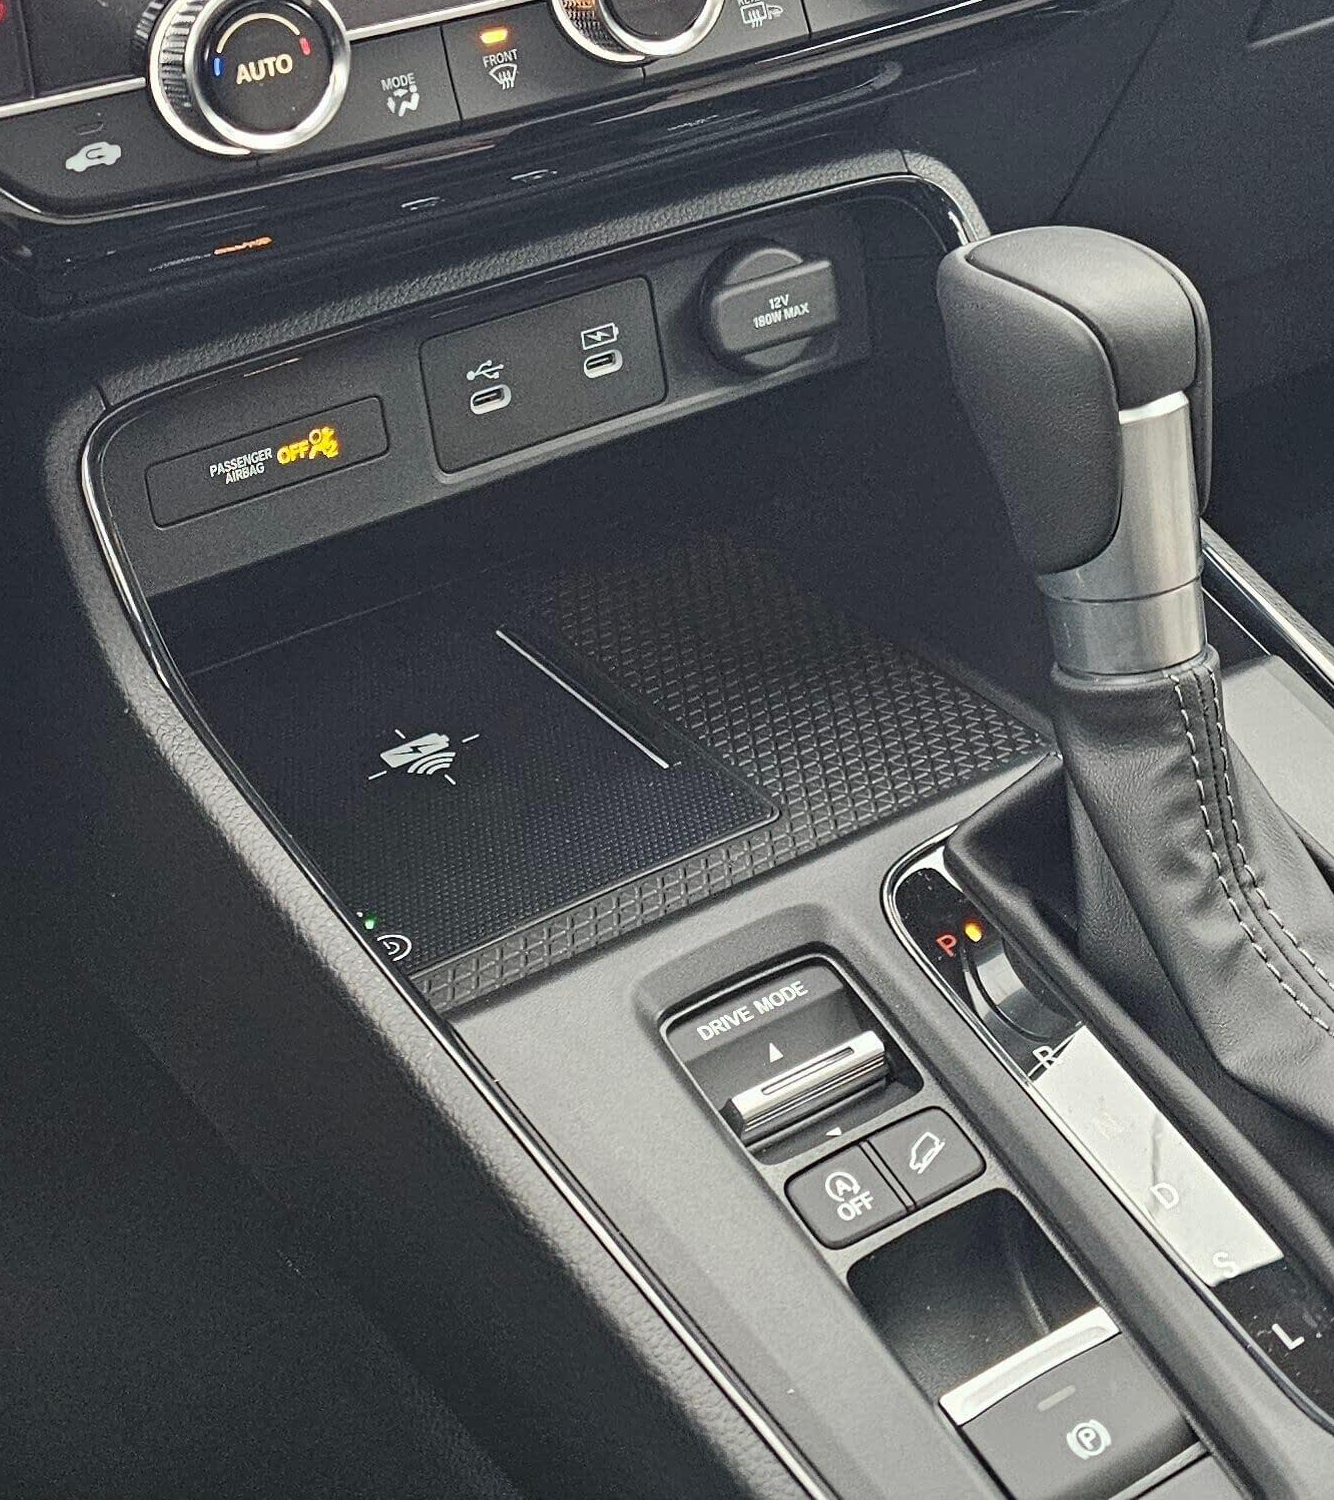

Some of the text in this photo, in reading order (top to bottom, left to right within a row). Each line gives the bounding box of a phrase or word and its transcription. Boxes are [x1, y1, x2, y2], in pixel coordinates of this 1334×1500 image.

[234, 53, 294, 86] AUTO
[482, 48, 519, 69] FRONT
[380, 71, 416, 92] MODE
[753, 302, 810, 329] 180W MAX
[769, 294, 789, 310] 12V
[209, 440, 309, 477] PASSENGER OFF
[225, 461, 265, 485] AIRBAG
[936, 933, 958, 956] P
[696, 979, 809, 1043] DRIVE MODE
[836, 1191, 875, 1222] OFF
[1150, 1182, 1179, 1210] D
[1212, 1251, 1238, 1278] S
[1271, 1322, 1305, 1350] L
